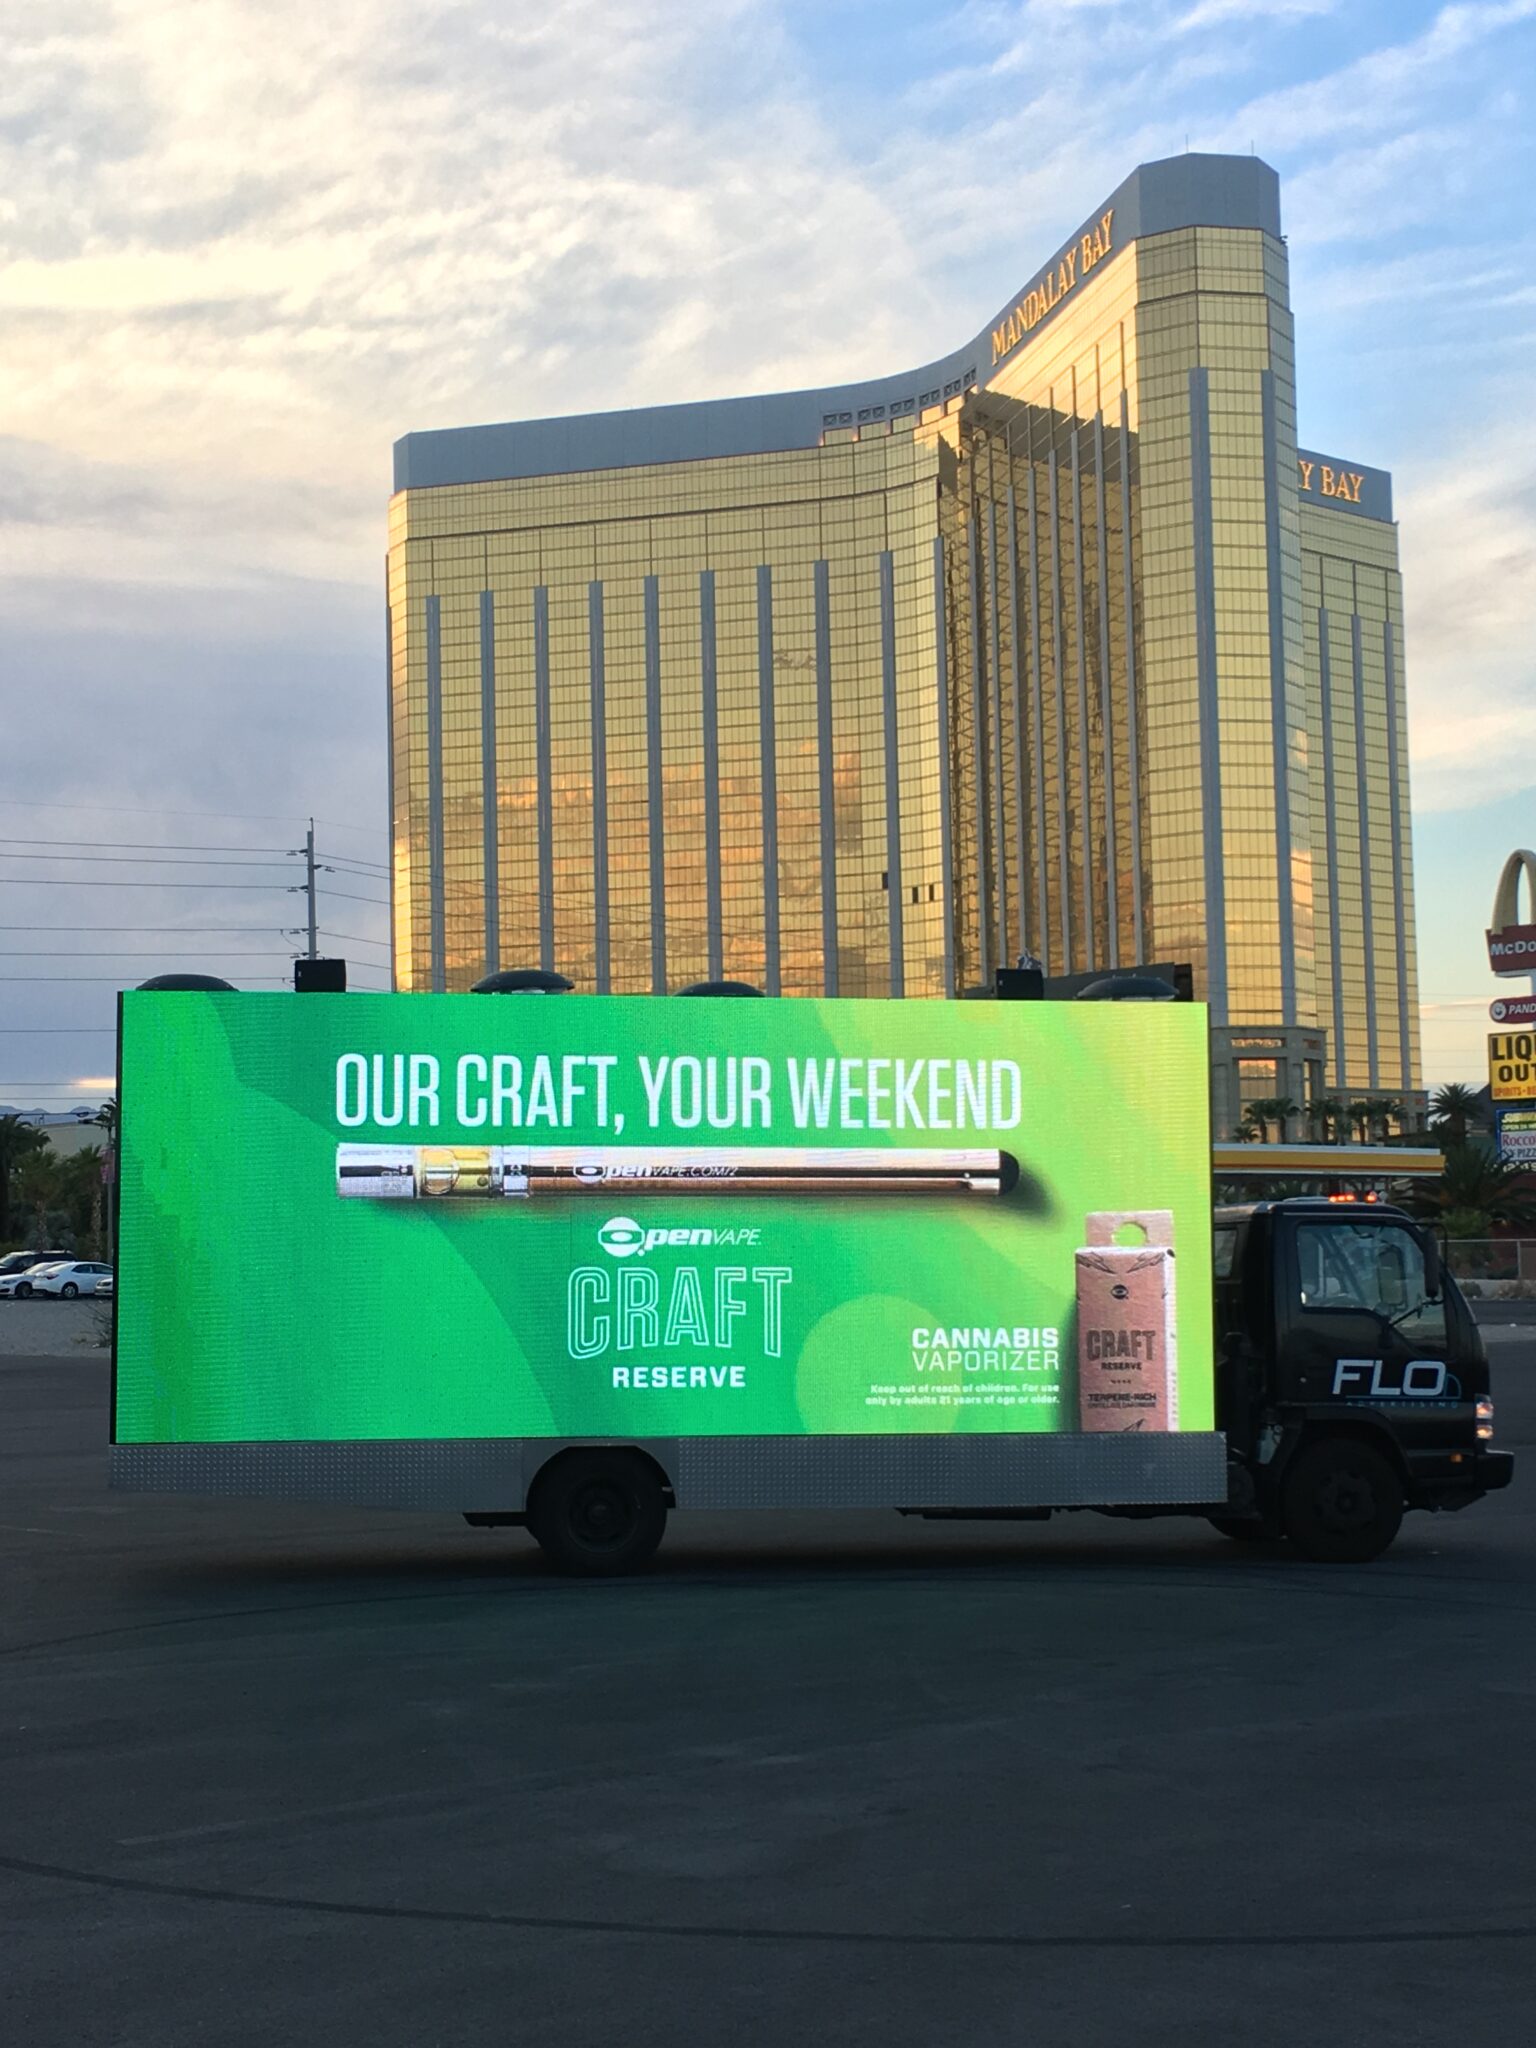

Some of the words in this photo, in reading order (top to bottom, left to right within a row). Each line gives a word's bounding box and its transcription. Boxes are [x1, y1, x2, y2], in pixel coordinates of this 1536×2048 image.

[991, 246, 1079, 366] MANDALAY
[1081, 209, 1115, 275] BAY
[1320, 465, 1364, 503] BAY
[1492, 1034, 1536, 1062] LIQ
[335, 1054, 440, 1129] OUR
[456, 1055, 625, 1136] CRAFT,
[638, 1056, 772, 1129] YOUR
[787, 1058, 1022, 1130] WEEKEND
[567, 1266, 793, 1360] CRAFT
[912, 1327, 1060, 1349] CANNABIS
[1086, 1329, 1157, 1362] CRAFT
[912, 1350, 1060, 1372] VAPORIZER
[1101, 1361, 1142, 1371] RESERVE
[612, 1366, 747, 1389] RESERVE
[870, 1384, 896, 1395] Keep
[898, 1384, 916, 1393] out
[918, 1384, 929, 1393] of
[931, 1383, 960, 1393] reach
[962, 1383, 973, 1393] of
[975, 1383, 1020, 1393] children.
[1022, 1383, 1039, 1393] For
[1041, 1384, 1060, 1393] use
[1331, 1358, 1447, 1396] FLO
[866, 1396, 887, 1407] only
[889, 1396, 901, 1407] by
[903, 1396, 937, 1405] adults
[939, 1396, 951, 1405] 21
[952, 1397, 982, 1407] years
[984, 1396, 994, 1405] of
[996, 1397, 1014, 1406] age
[1017, 1397, 1028, 1405] or
[1031, 1395, 1060, 1404] older.
